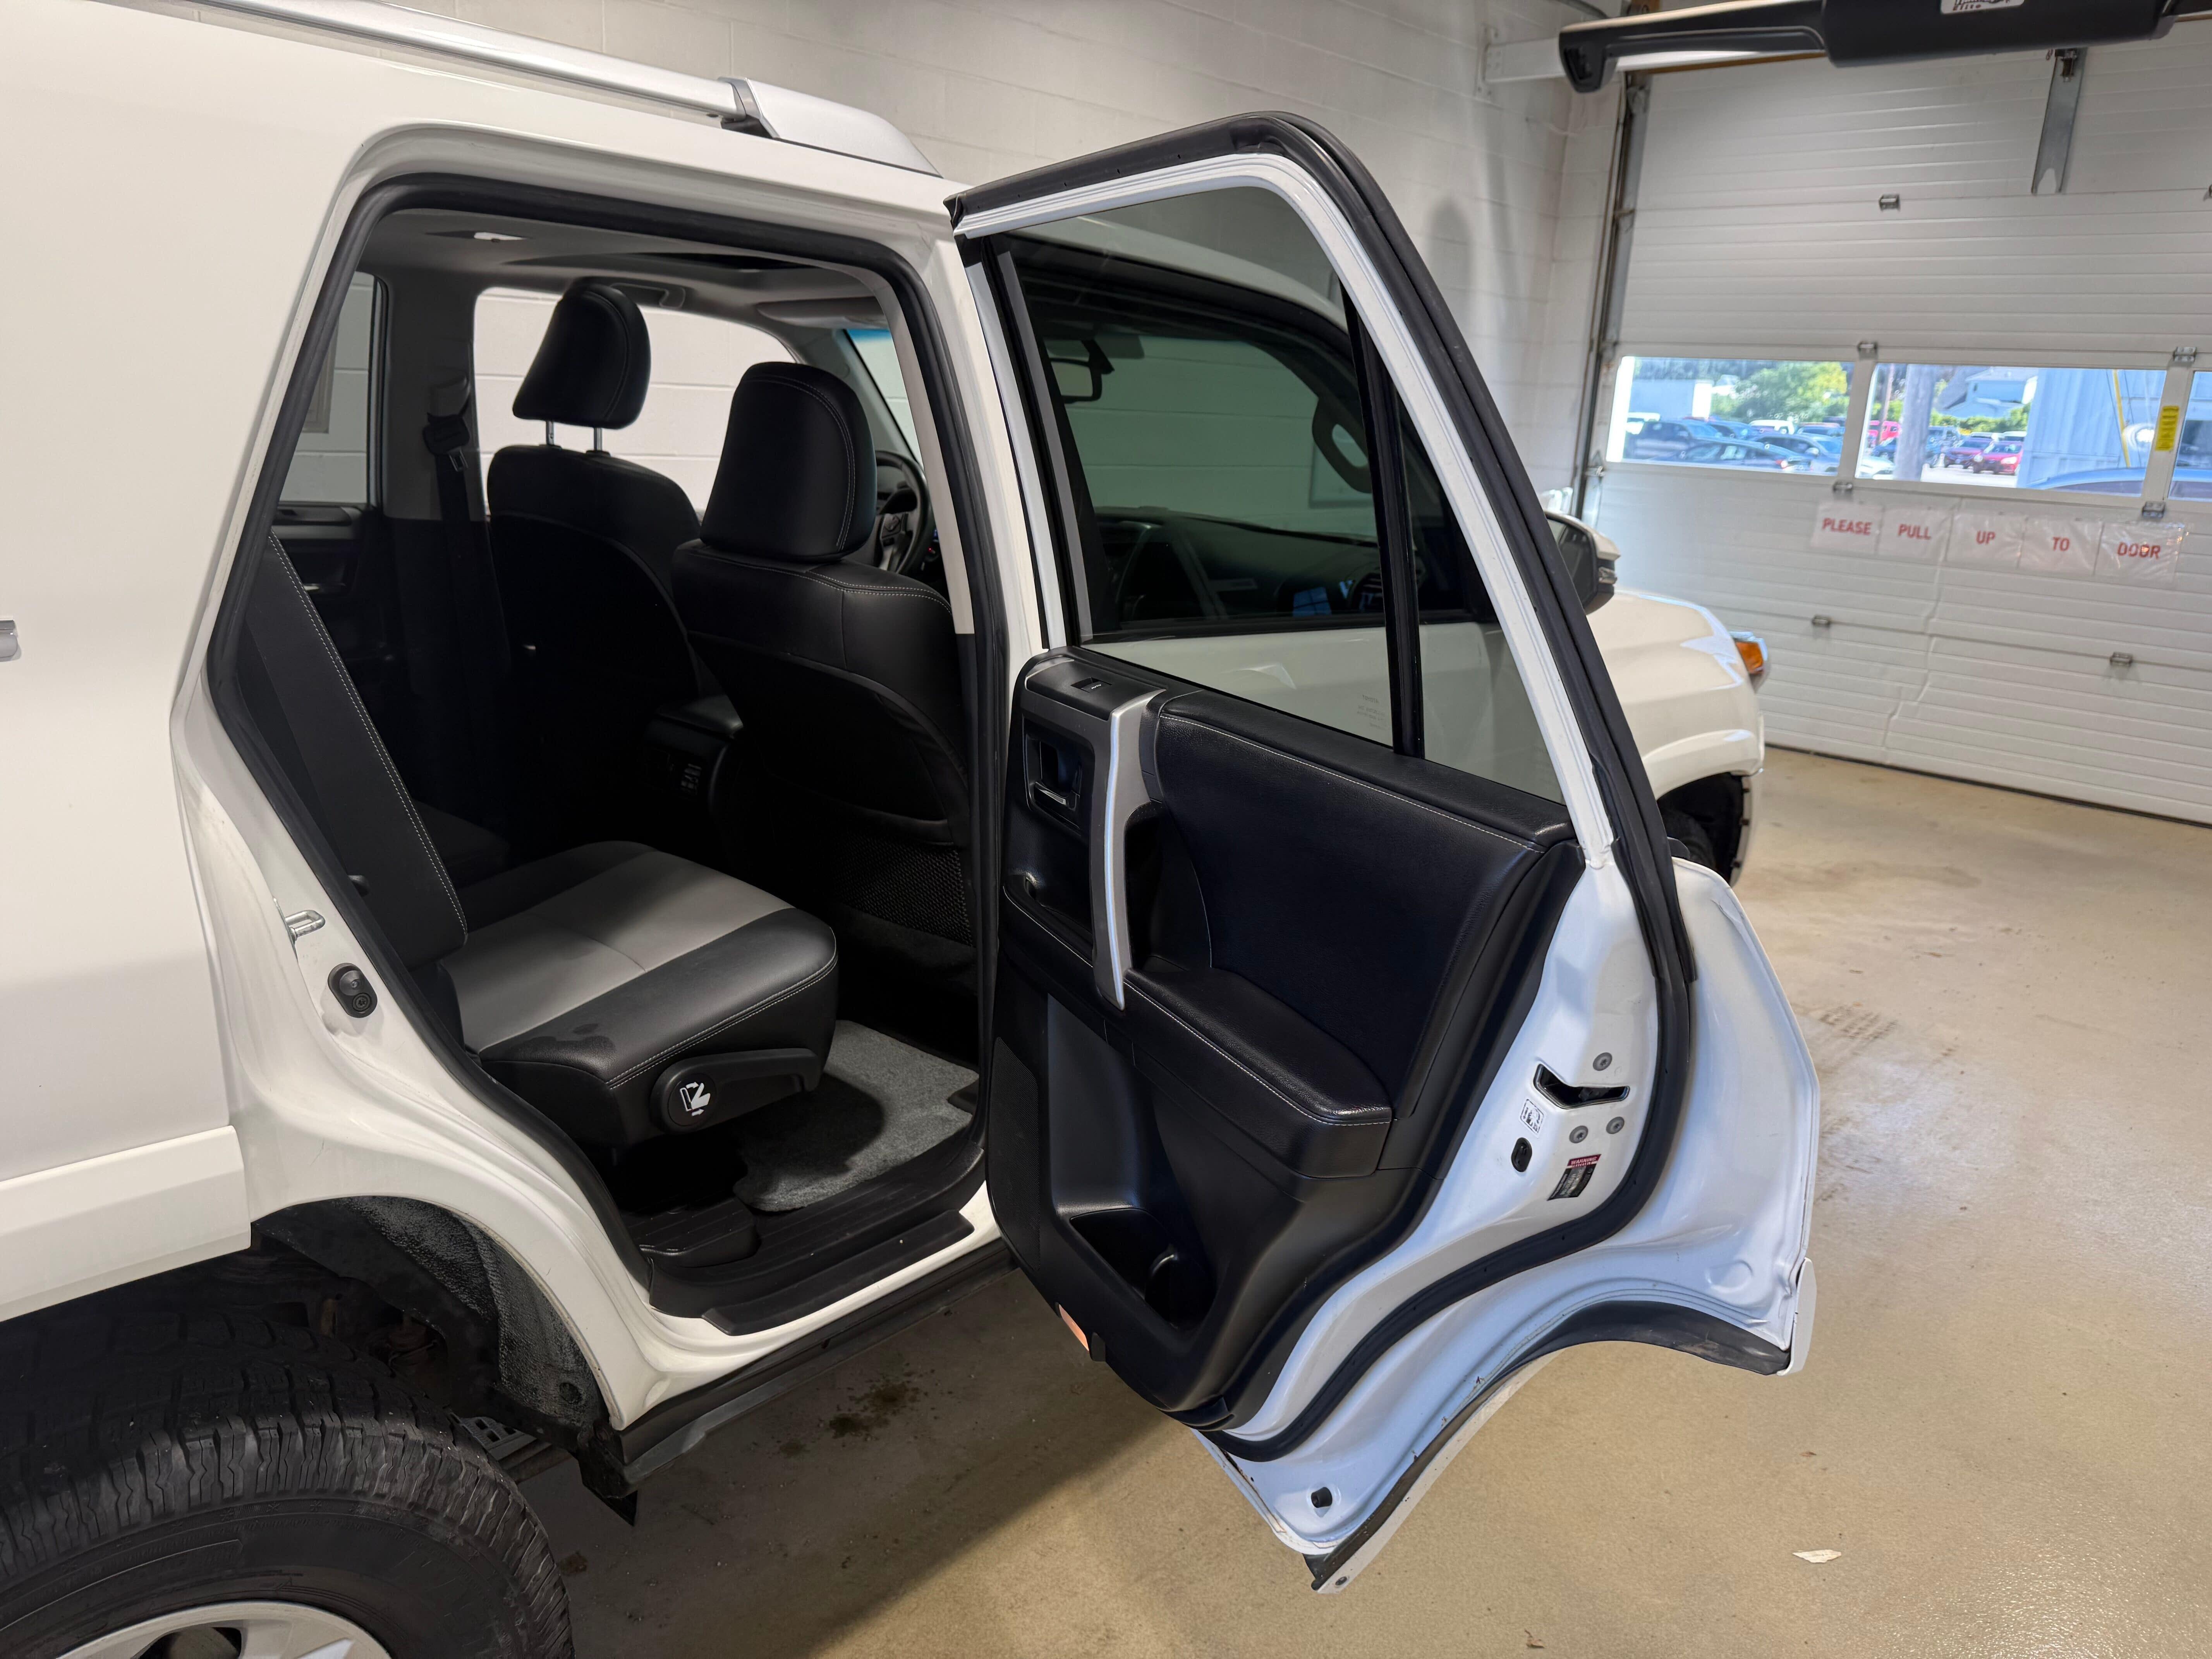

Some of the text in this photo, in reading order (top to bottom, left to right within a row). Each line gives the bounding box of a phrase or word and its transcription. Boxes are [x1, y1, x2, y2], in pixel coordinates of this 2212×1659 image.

[1822, 518, 2160, 559] PLEASE PULL UP TO DOOR
